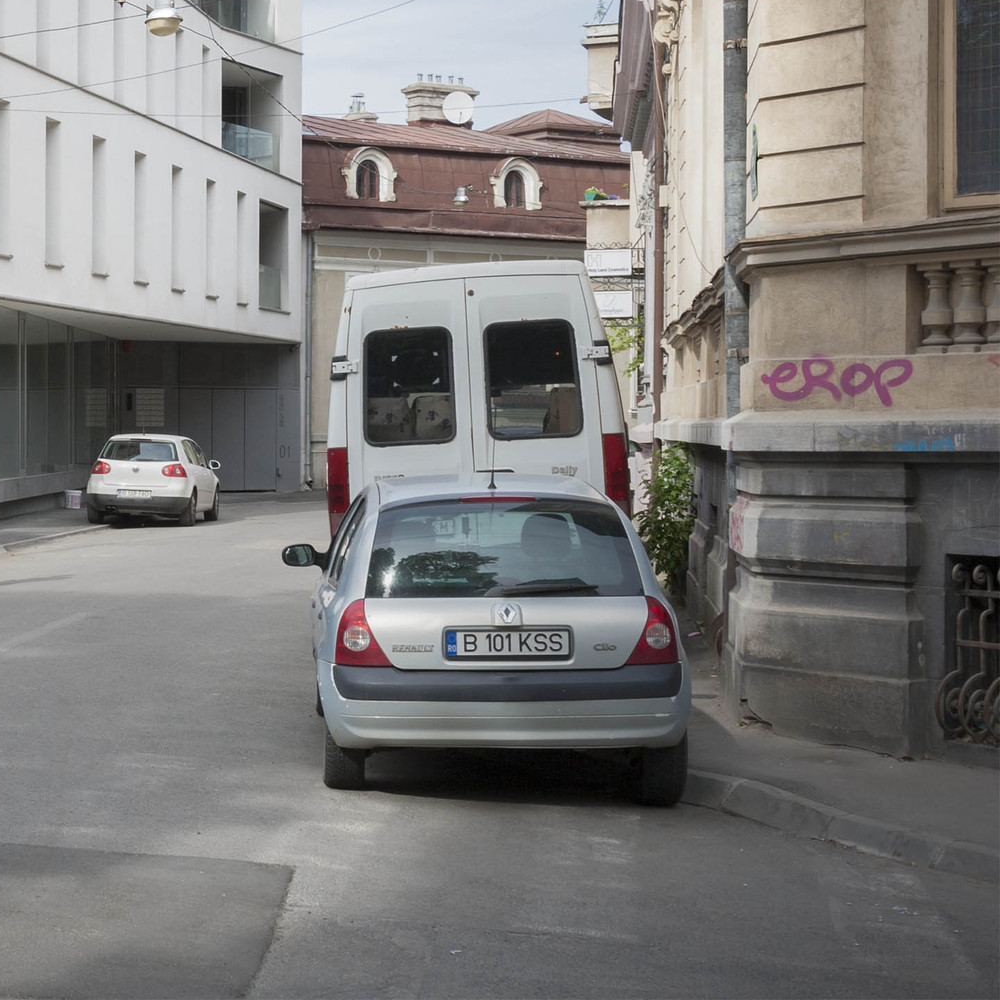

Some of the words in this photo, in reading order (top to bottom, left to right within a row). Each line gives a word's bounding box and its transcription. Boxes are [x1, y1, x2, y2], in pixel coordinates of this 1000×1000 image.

[392, 643, 435, 653] RENAULT
[463, 633, 478, 653] B
[485, 633, 512, 653] 101
[519, 633, 563, 653] KSS
